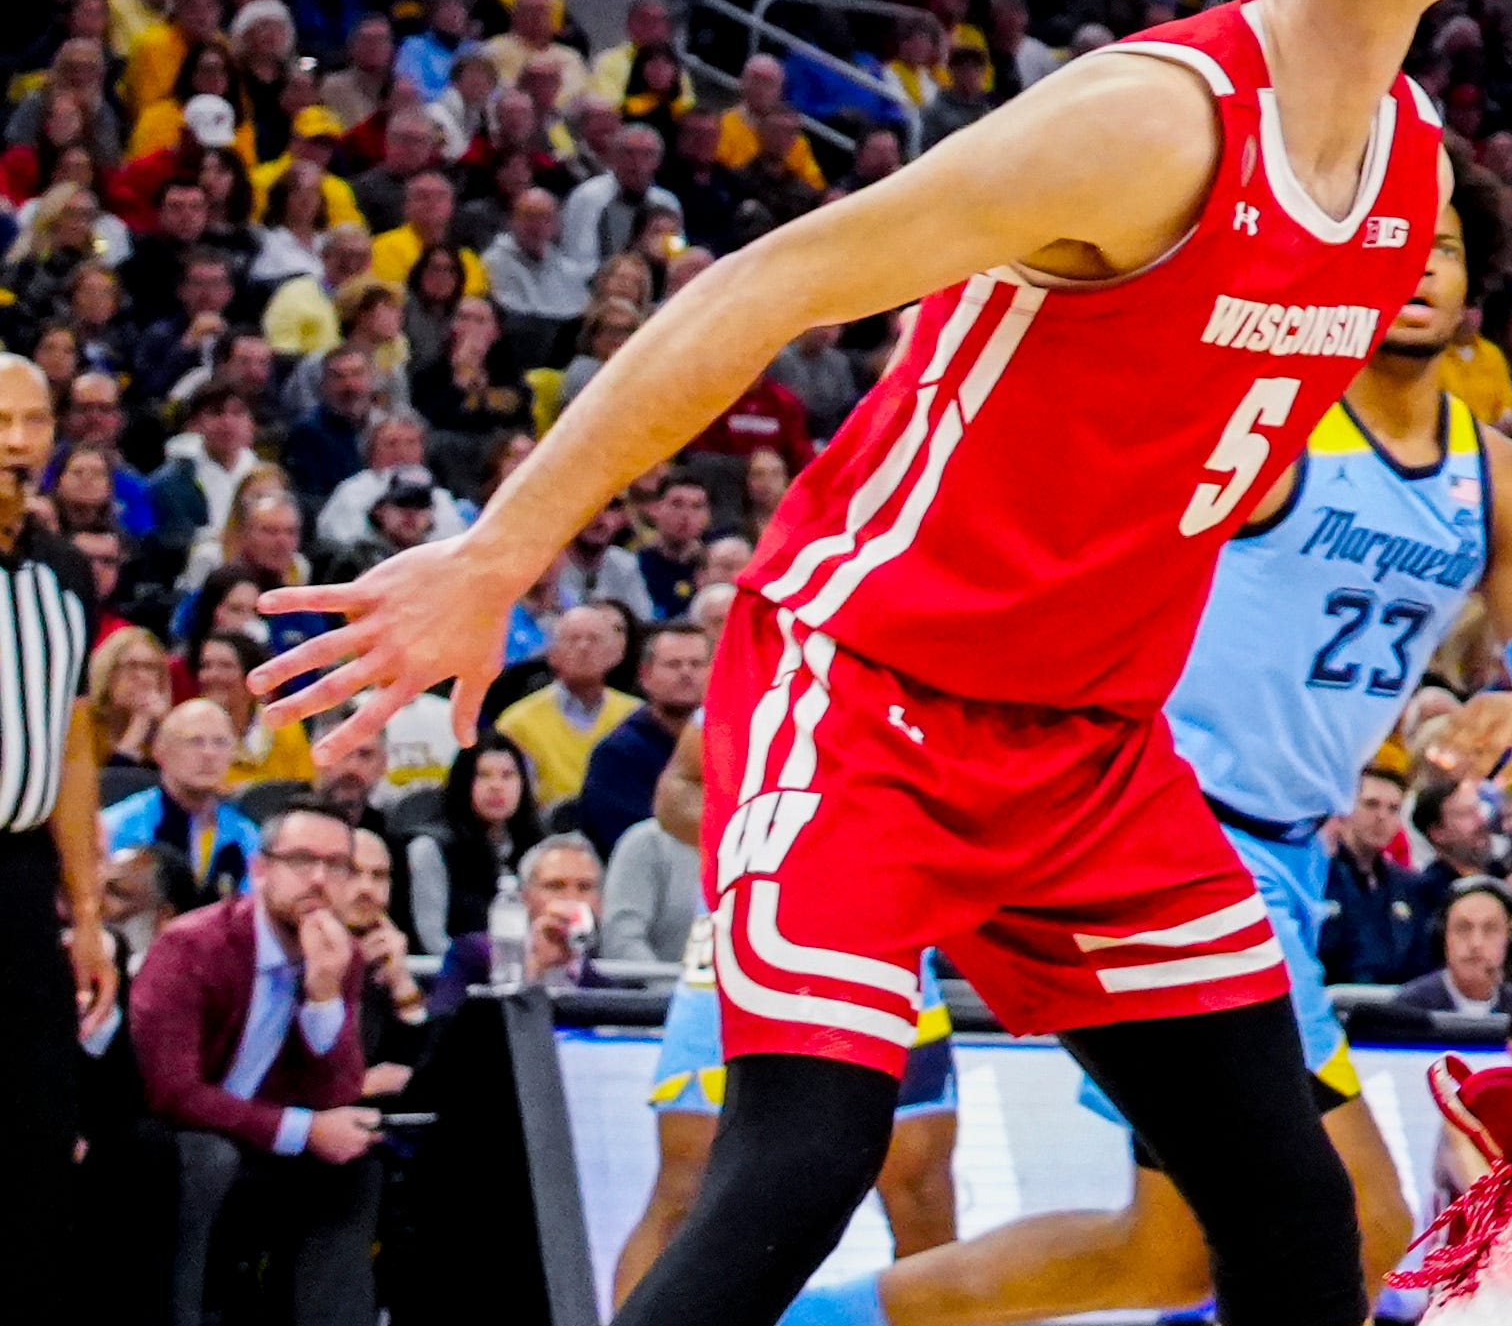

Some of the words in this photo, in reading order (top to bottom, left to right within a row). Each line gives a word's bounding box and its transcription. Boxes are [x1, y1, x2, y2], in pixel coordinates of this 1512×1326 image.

[1200, 294, 1381, 359] WISCONSIN
[1178, 376, 1301, 537] 5
[1306, 587, 1434, 698] 23
[716, 790, 824, 895] W
